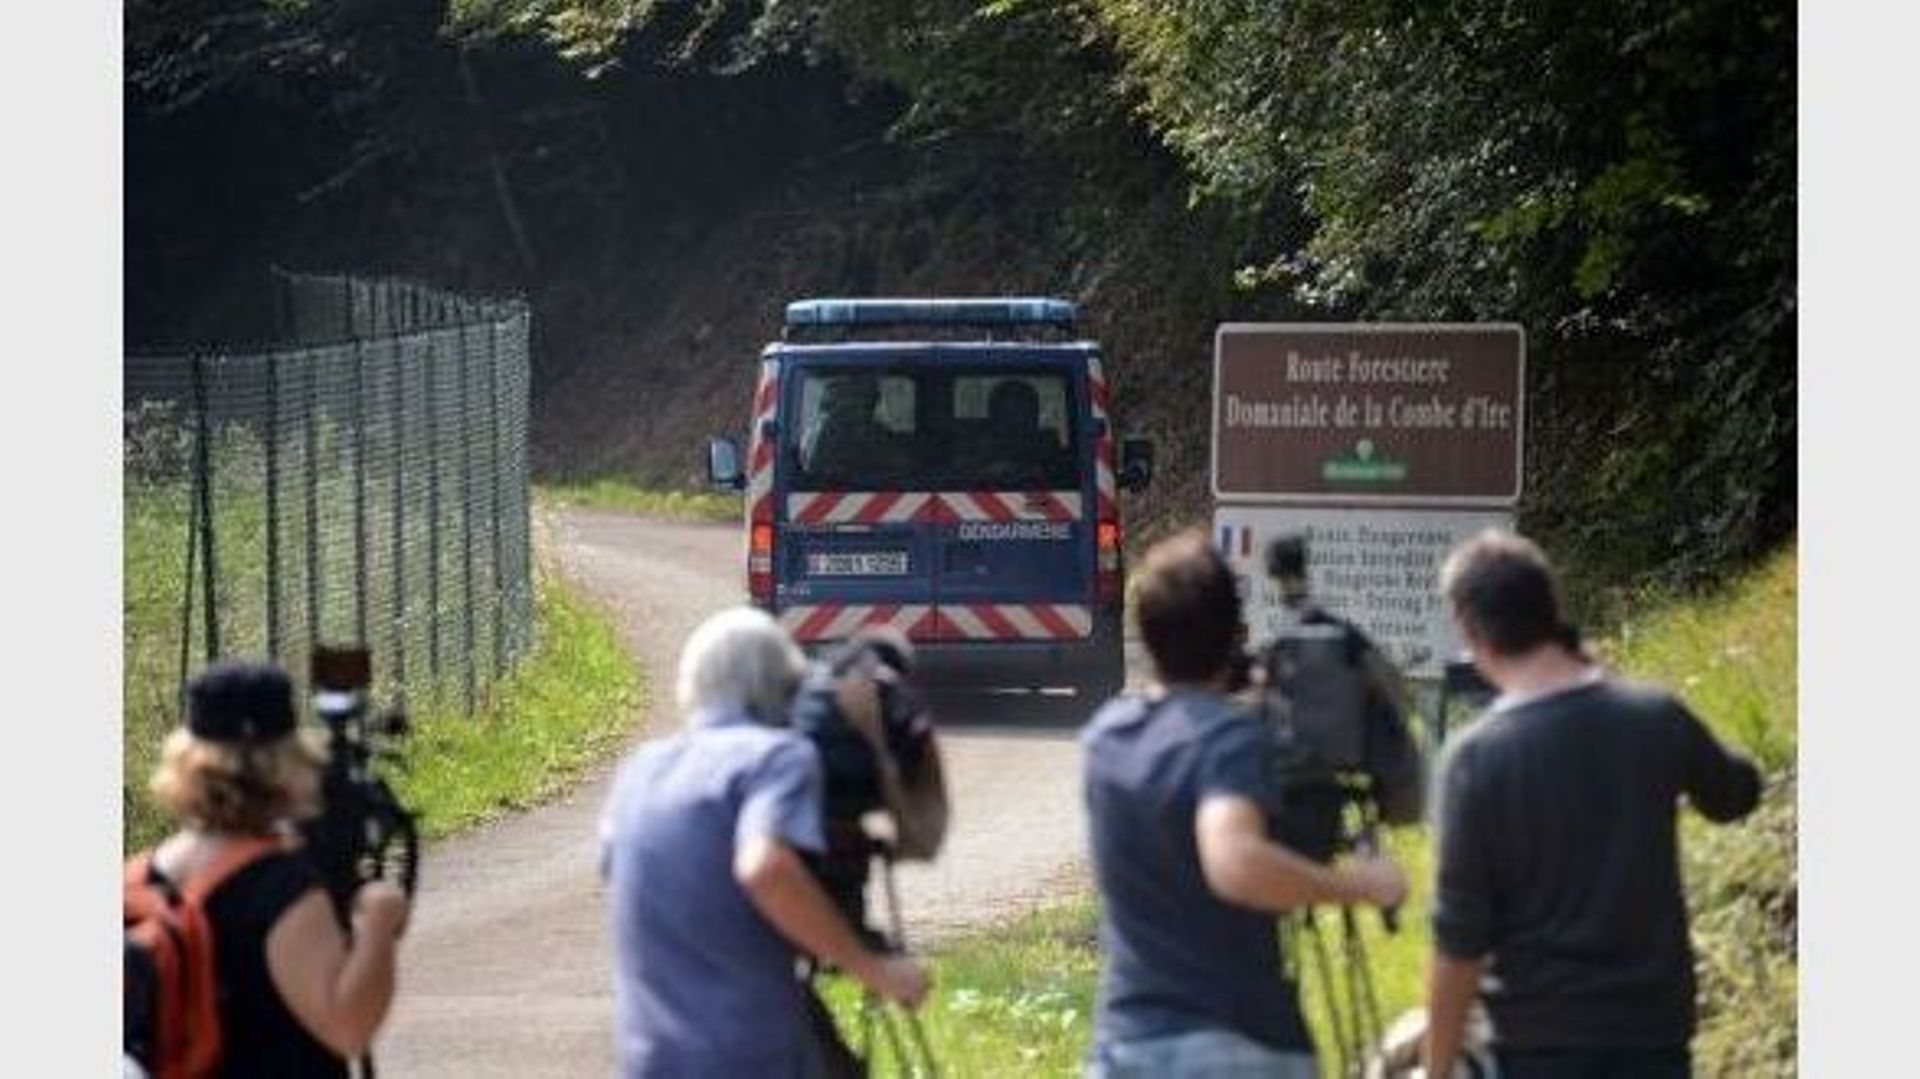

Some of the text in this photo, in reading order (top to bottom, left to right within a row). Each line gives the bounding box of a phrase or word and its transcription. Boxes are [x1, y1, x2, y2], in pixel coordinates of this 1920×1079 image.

[1287, 352, 1343, 382] Route
[1227, 396, 1329, 428] Domaniale
[1335, 396, 1359, 428] de
[1365, 396, 1384, 428] la
[1388, 396, 1455, 428] Combe
[960, 522, 1072, 540] GENDARMERIE
